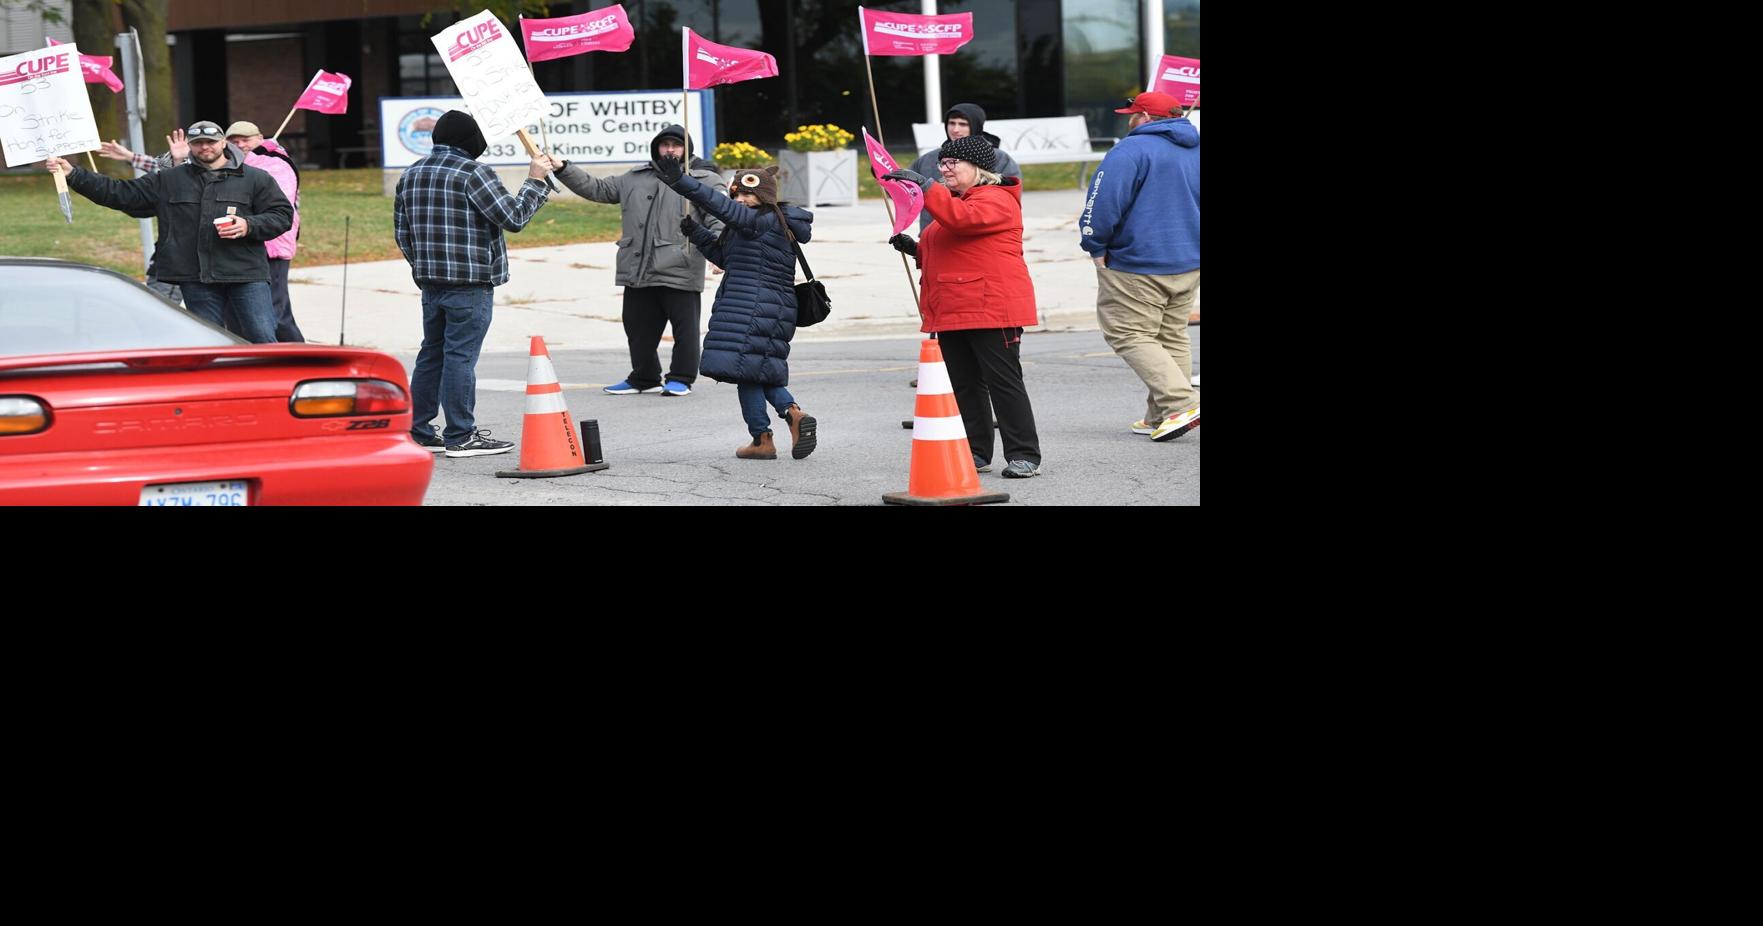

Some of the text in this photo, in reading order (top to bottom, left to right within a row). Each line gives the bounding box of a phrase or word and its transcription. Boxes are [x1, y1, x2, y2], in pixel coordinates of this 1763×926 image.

[456, 18, 500, 49] CUPE
[543, 14, 617, 36] CUPE SCFP
[884, 21, 962, 33] CUPE SCFP
[16, 53, 69, 77] CUPE
[590, 99, 682, 117] WHITBY
[602, 119, 671, 134] Centre
[344, 419, 391, 431] Z28
[561, 411, 577, 457] TELECON
